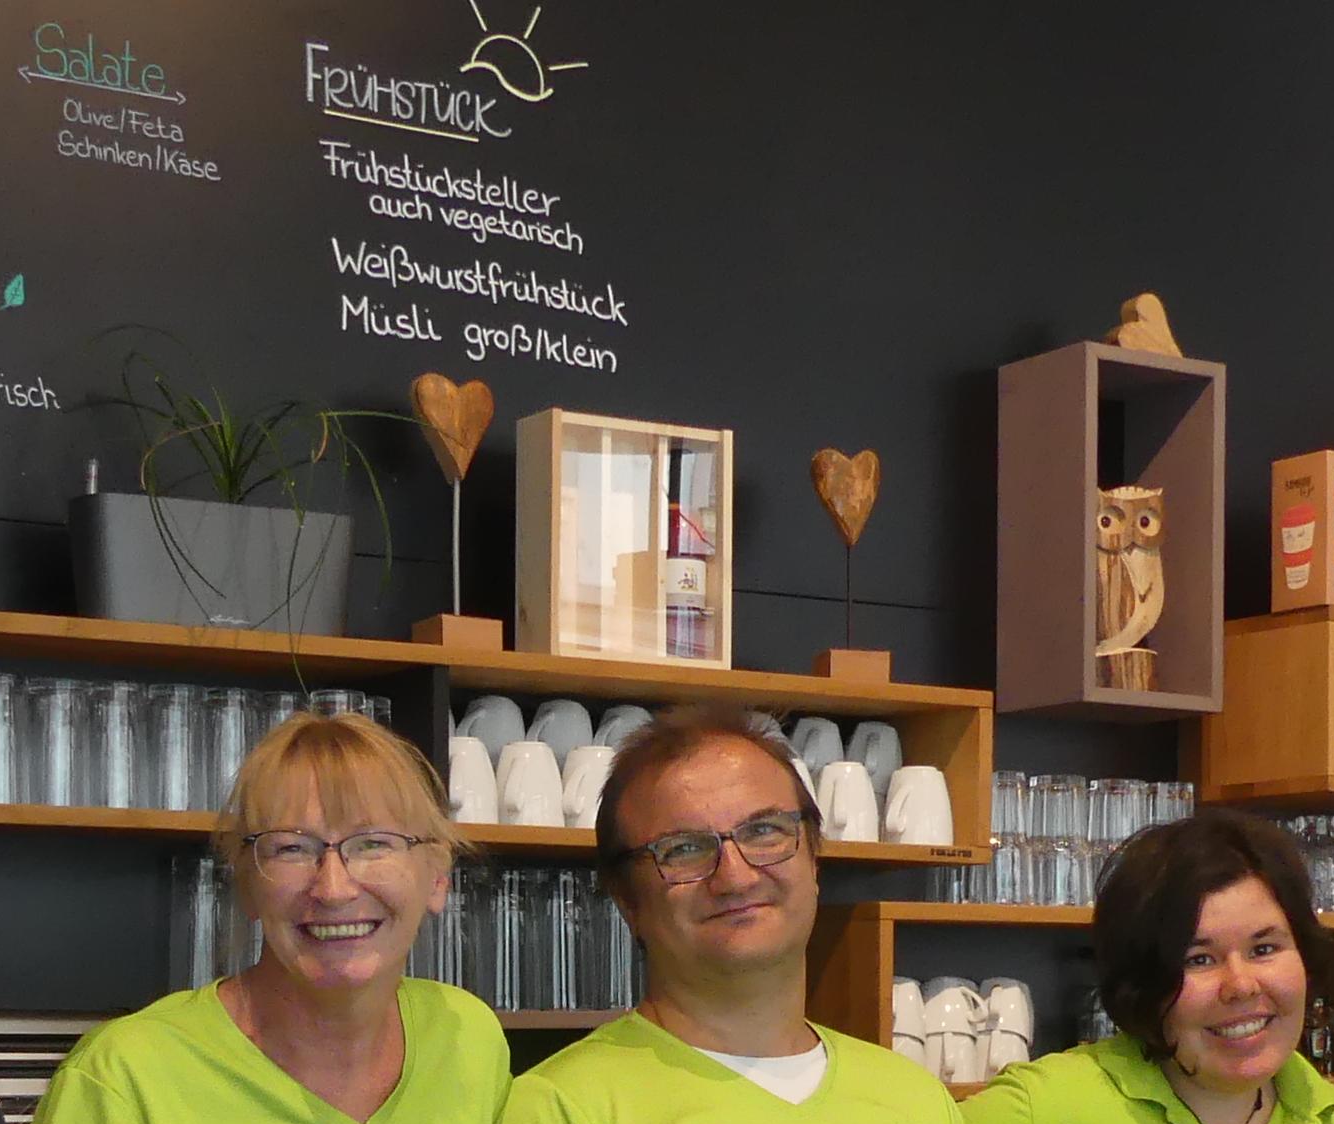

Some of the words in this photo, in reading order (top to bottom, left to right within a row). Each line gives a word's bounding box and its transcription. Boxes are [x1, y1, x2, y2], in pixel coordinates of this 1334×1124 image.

[35, 23, 166, 96] Salate
[58, 130, 222, 182] Schinken/Käse
[63, 98, 185, 143] Olive/Feta
[320, 140, 560, 218] Frühstücksteller
[369, 195, 432, 222] auch
[440, 205, 584, 255] vegetarisch
[332, 237, 628, 326] Weißwurstfrühstück
[340, 295, 442, 342] Müsli
[464, 321, 618, 374] groß/klein
